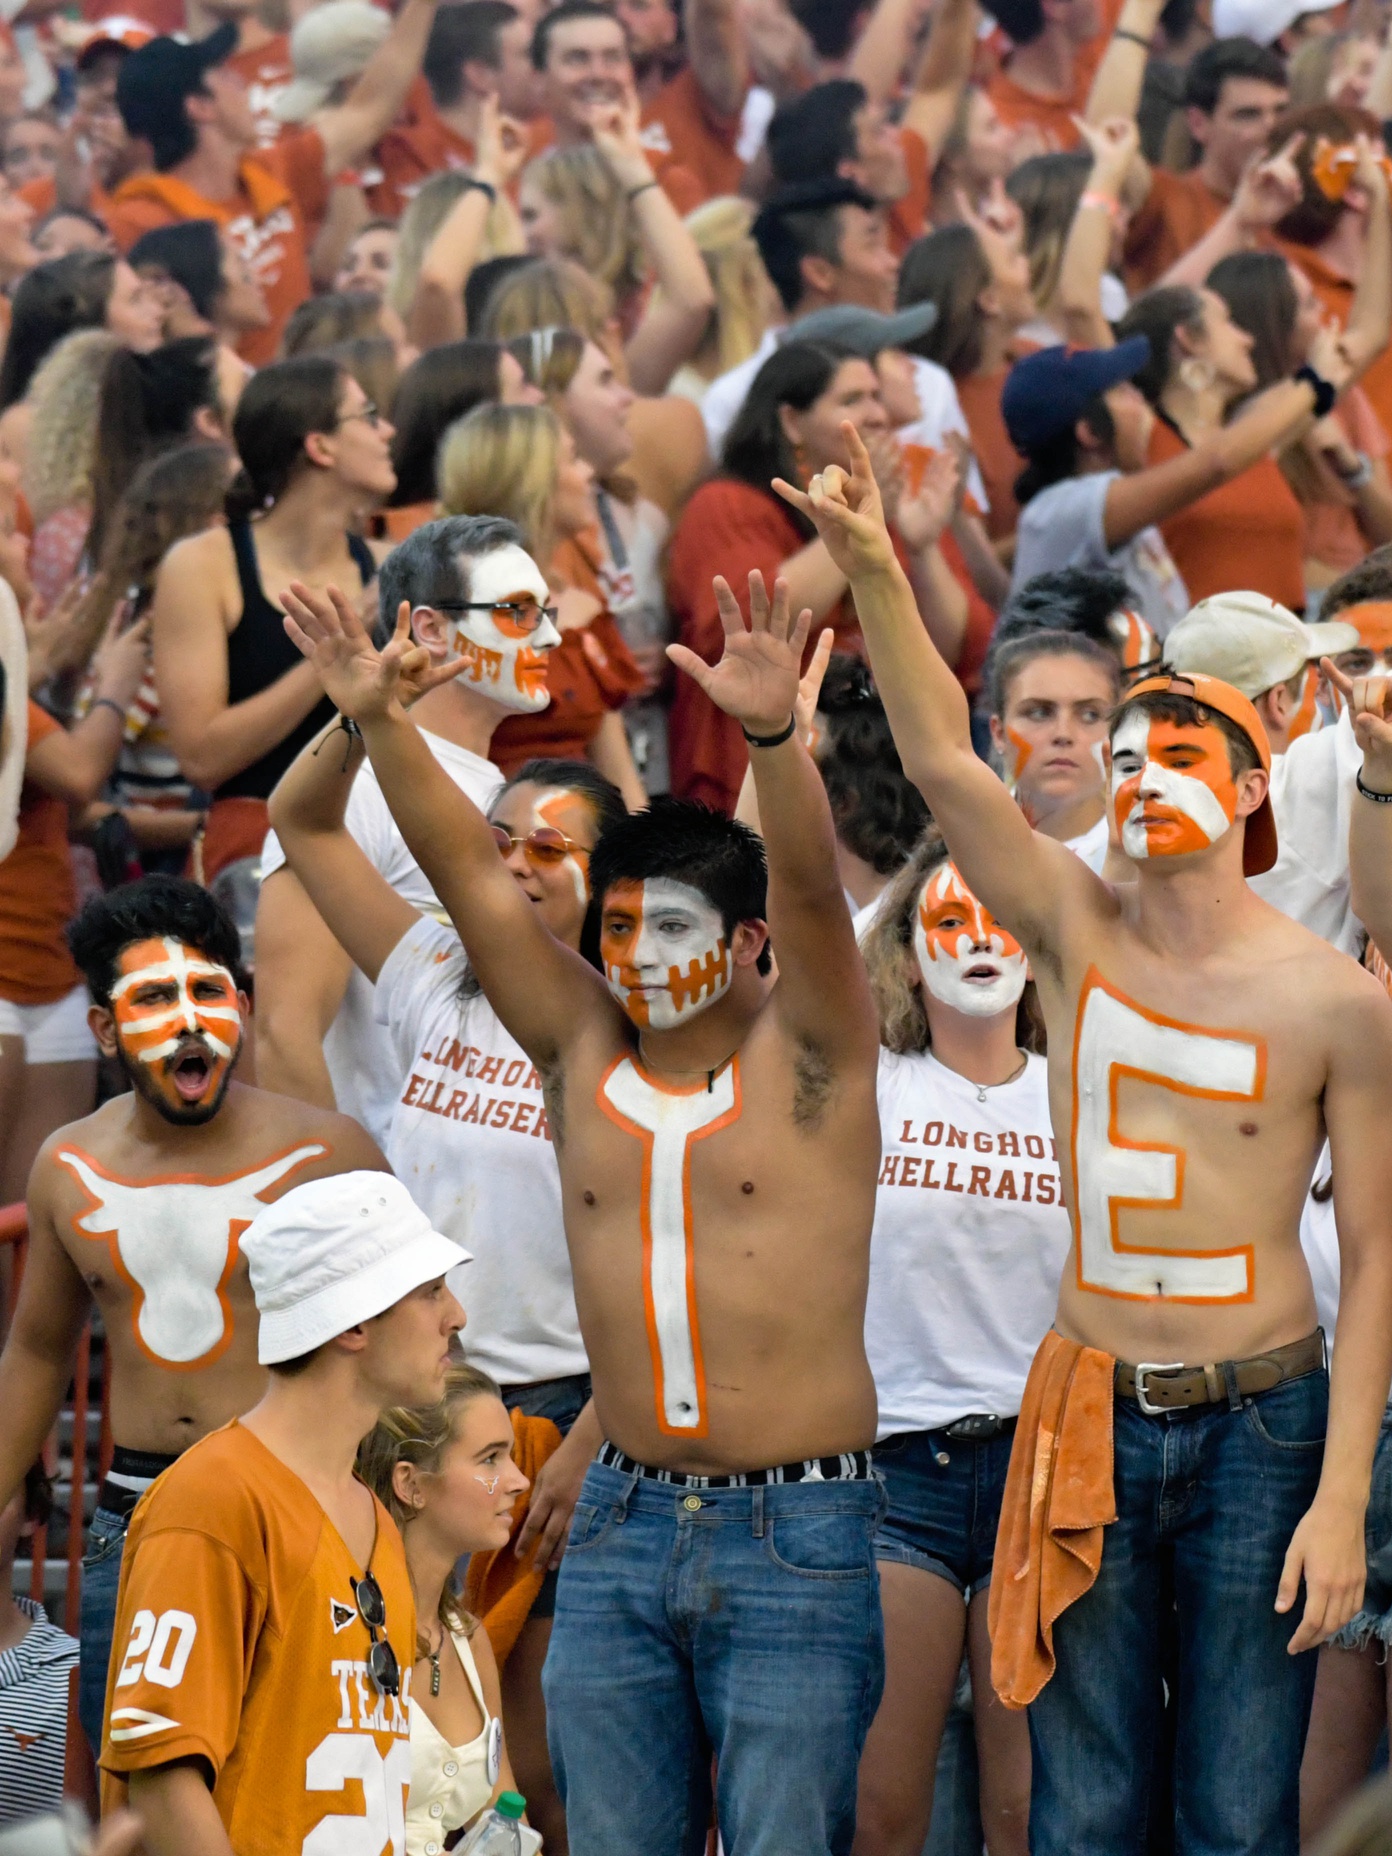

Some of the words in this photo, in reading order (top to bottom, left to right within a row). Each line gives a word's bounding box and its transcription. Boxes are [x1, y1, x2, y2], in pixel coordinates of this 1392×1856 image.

[596, 1050, 742, 1437] T
[1072, 964, 1268, 1306] E
[115, 1609, 198, 1689] 20
